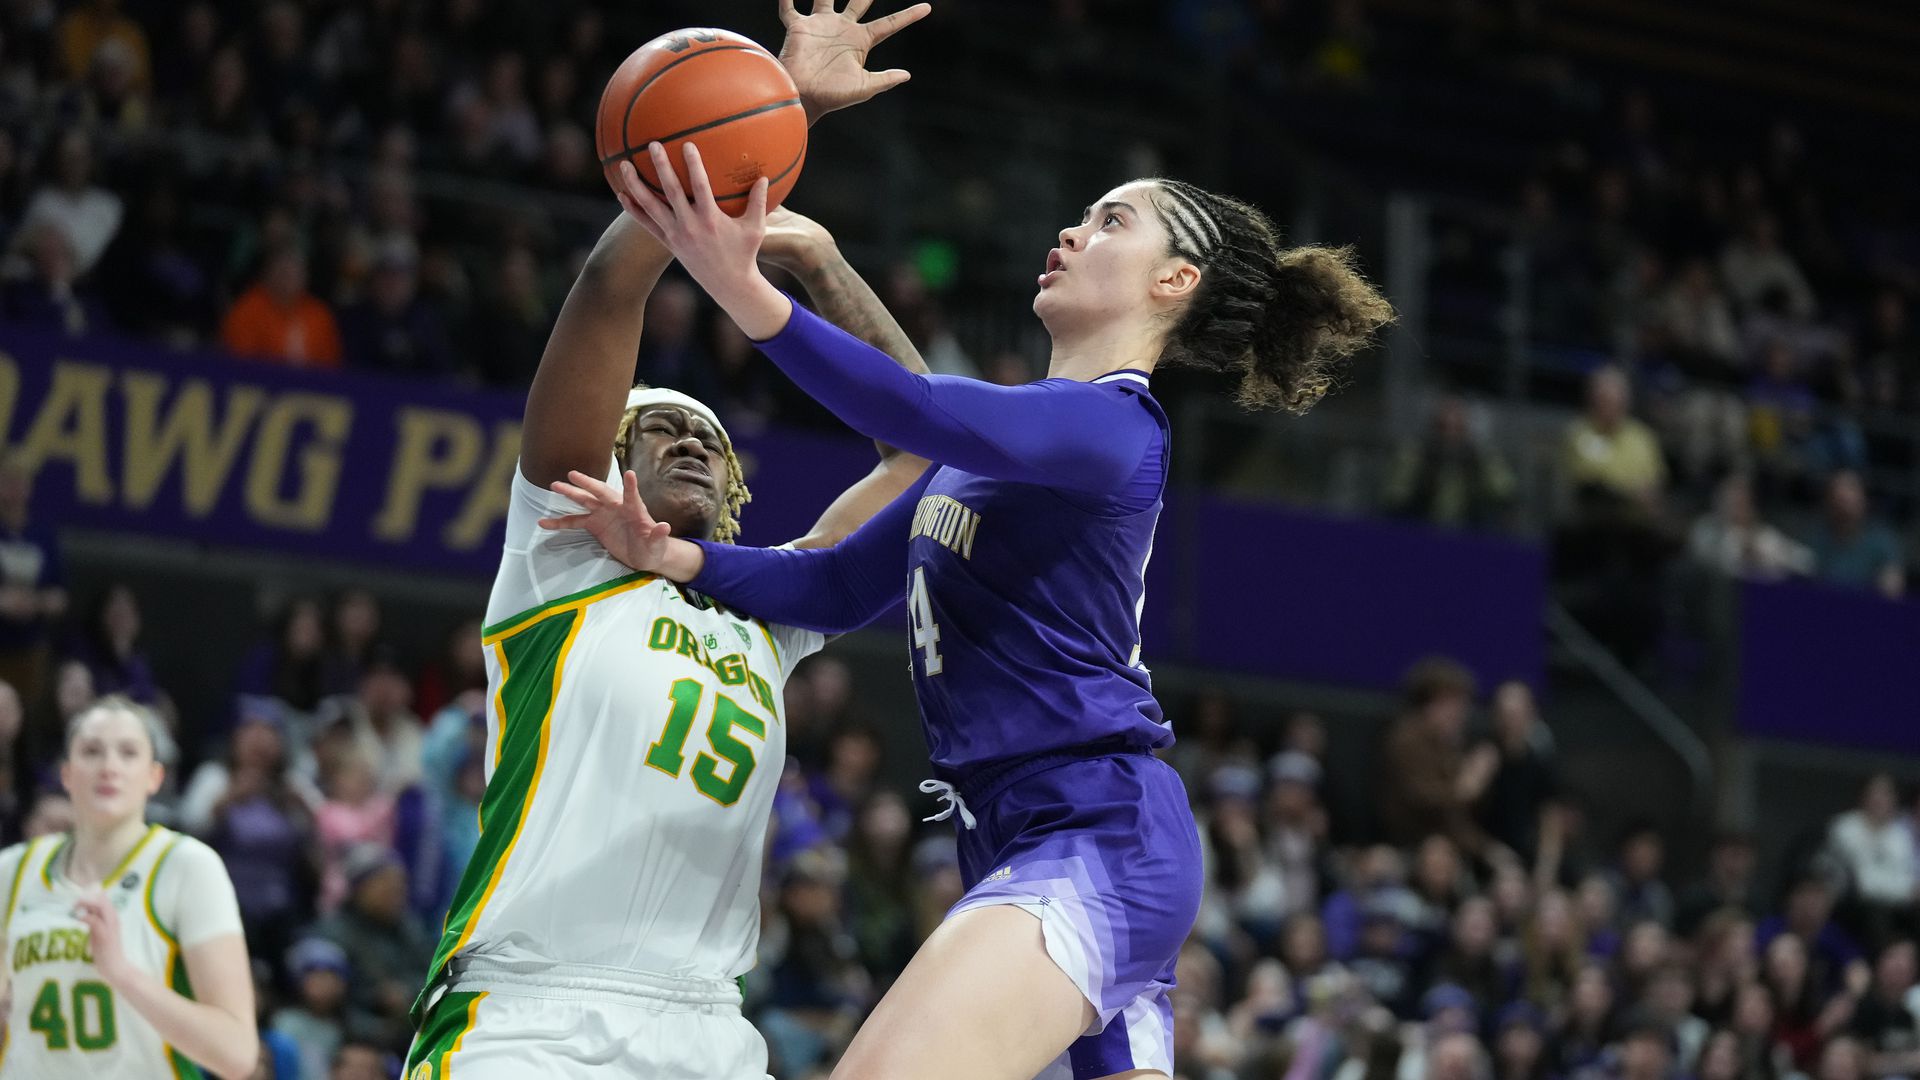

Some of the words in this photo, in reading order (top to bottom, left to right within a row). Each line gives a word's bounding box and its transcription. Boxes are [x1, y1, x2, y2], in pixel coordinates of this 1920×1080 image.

[0, 350, 353, 533] AWG
[907, 566, 943, 680] 4
[644, 677, 766, 808] 15
[29, 977, 118, 1052] 40
